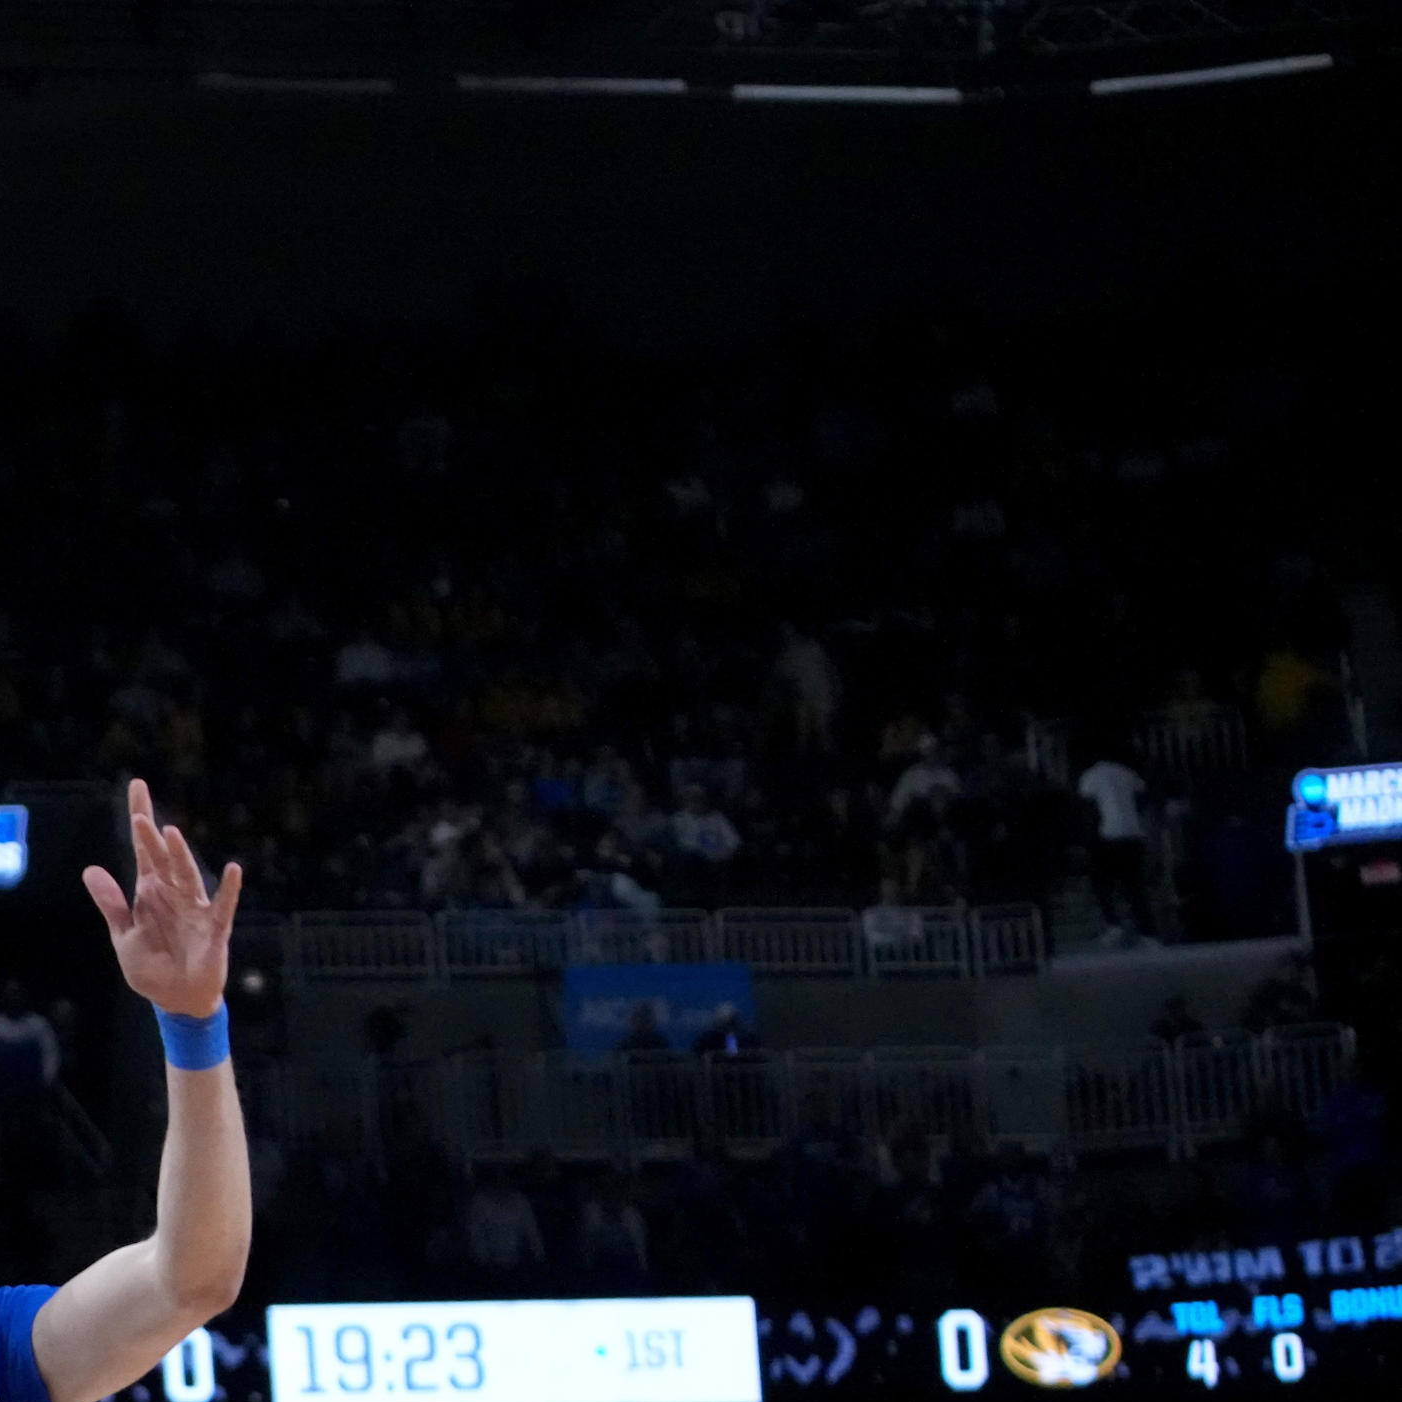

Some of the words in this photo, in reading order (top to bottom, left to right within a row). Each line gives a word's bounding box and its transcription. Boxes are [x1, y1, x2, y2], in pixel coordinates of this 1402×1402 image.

[1253, 1293, 1304, 1327] FLS
[296, 1321, 487, 1395] 19:23
[624, 1328, 688, 1371] 1ST
[938, 1308, 989, 1391] 0
[1187, 1339, 1220, 1388] 4
[1272, 1332, 1306, 1382] 0
